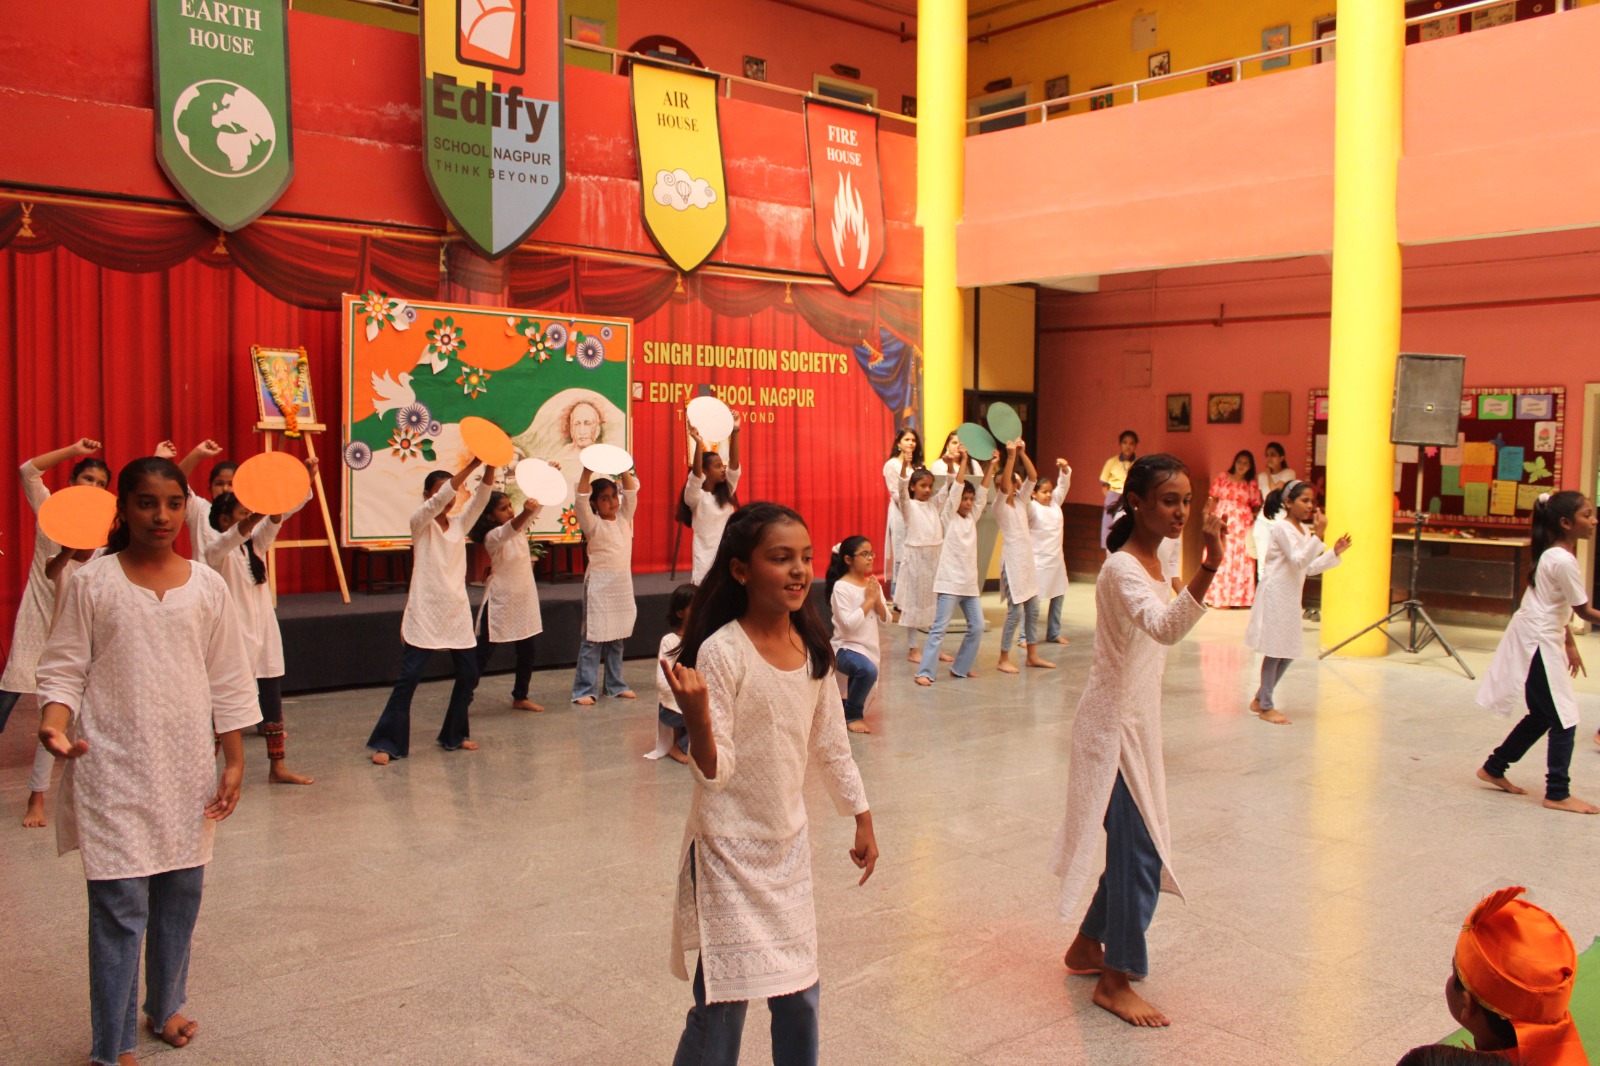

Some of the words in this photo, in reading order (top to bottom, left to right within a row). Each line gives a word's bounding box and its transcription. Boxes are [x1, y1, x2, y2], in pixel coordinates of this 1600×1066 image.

[181, 0, 262, 31] EARTH
[189, 27, 255, 56] HOUSE
[433, 72, 549, 143] Edify
[663, 90, 690, 110] AIR
[657, 112, 699, 132] HOUSE
[827, 124, 858, 147] FIRE
[434, 136, 490, 158] SCHOOL
[493, 147, 551, 166] NAGPUR
[826, 146, 862, 167] HOUSE
[436, 159, 480, 177] THINK
[488, 169, 549, 185] BEYOND
[643, 341, 692, 366] SINGH
[696, 344, 777, 371] EDUCATION
[780, 350, 848, 374] SOCIETY'S
[649, 382, 694, 404] EDIFY
[760, 387, 815, 408] NAGPUR
[742, 411, 775, 423] YOND
